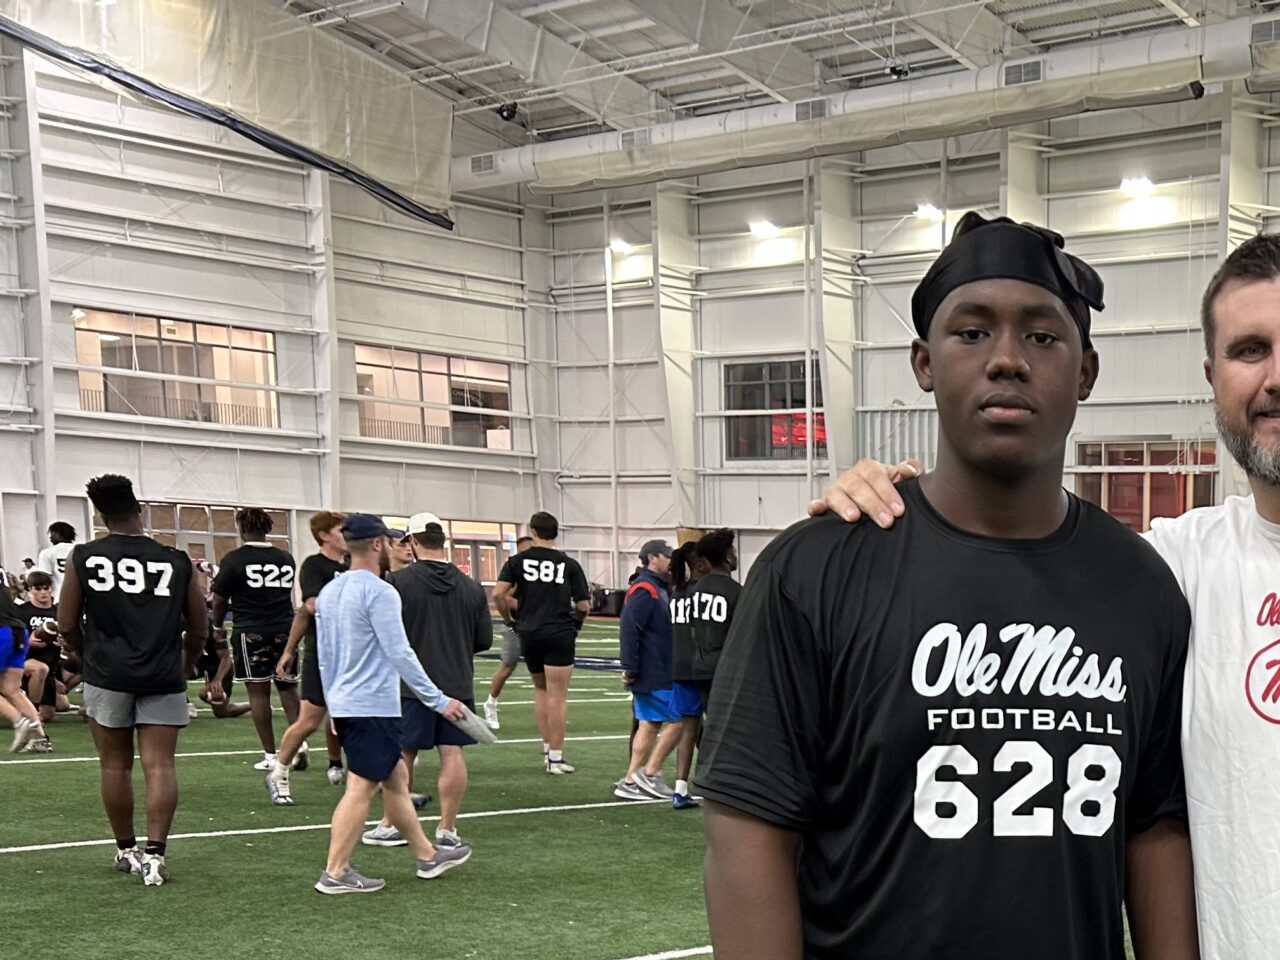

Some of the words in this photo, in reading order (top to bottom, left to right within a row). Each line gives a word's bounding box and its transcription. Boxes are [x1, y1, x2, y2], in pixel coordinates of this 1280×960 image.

[85, 555, 174, 597] 397
[245, 564, 294, 588] 522
[523, 559, 566, 585] 581
[692, 591, 728, 623] 170
[911, 622, 1002, 698] Ole
[998, 623, 1127, 703] Miss
[927, 708, 1123, 736] FOOTBALL
[913, 740, 1123, 840] 628
